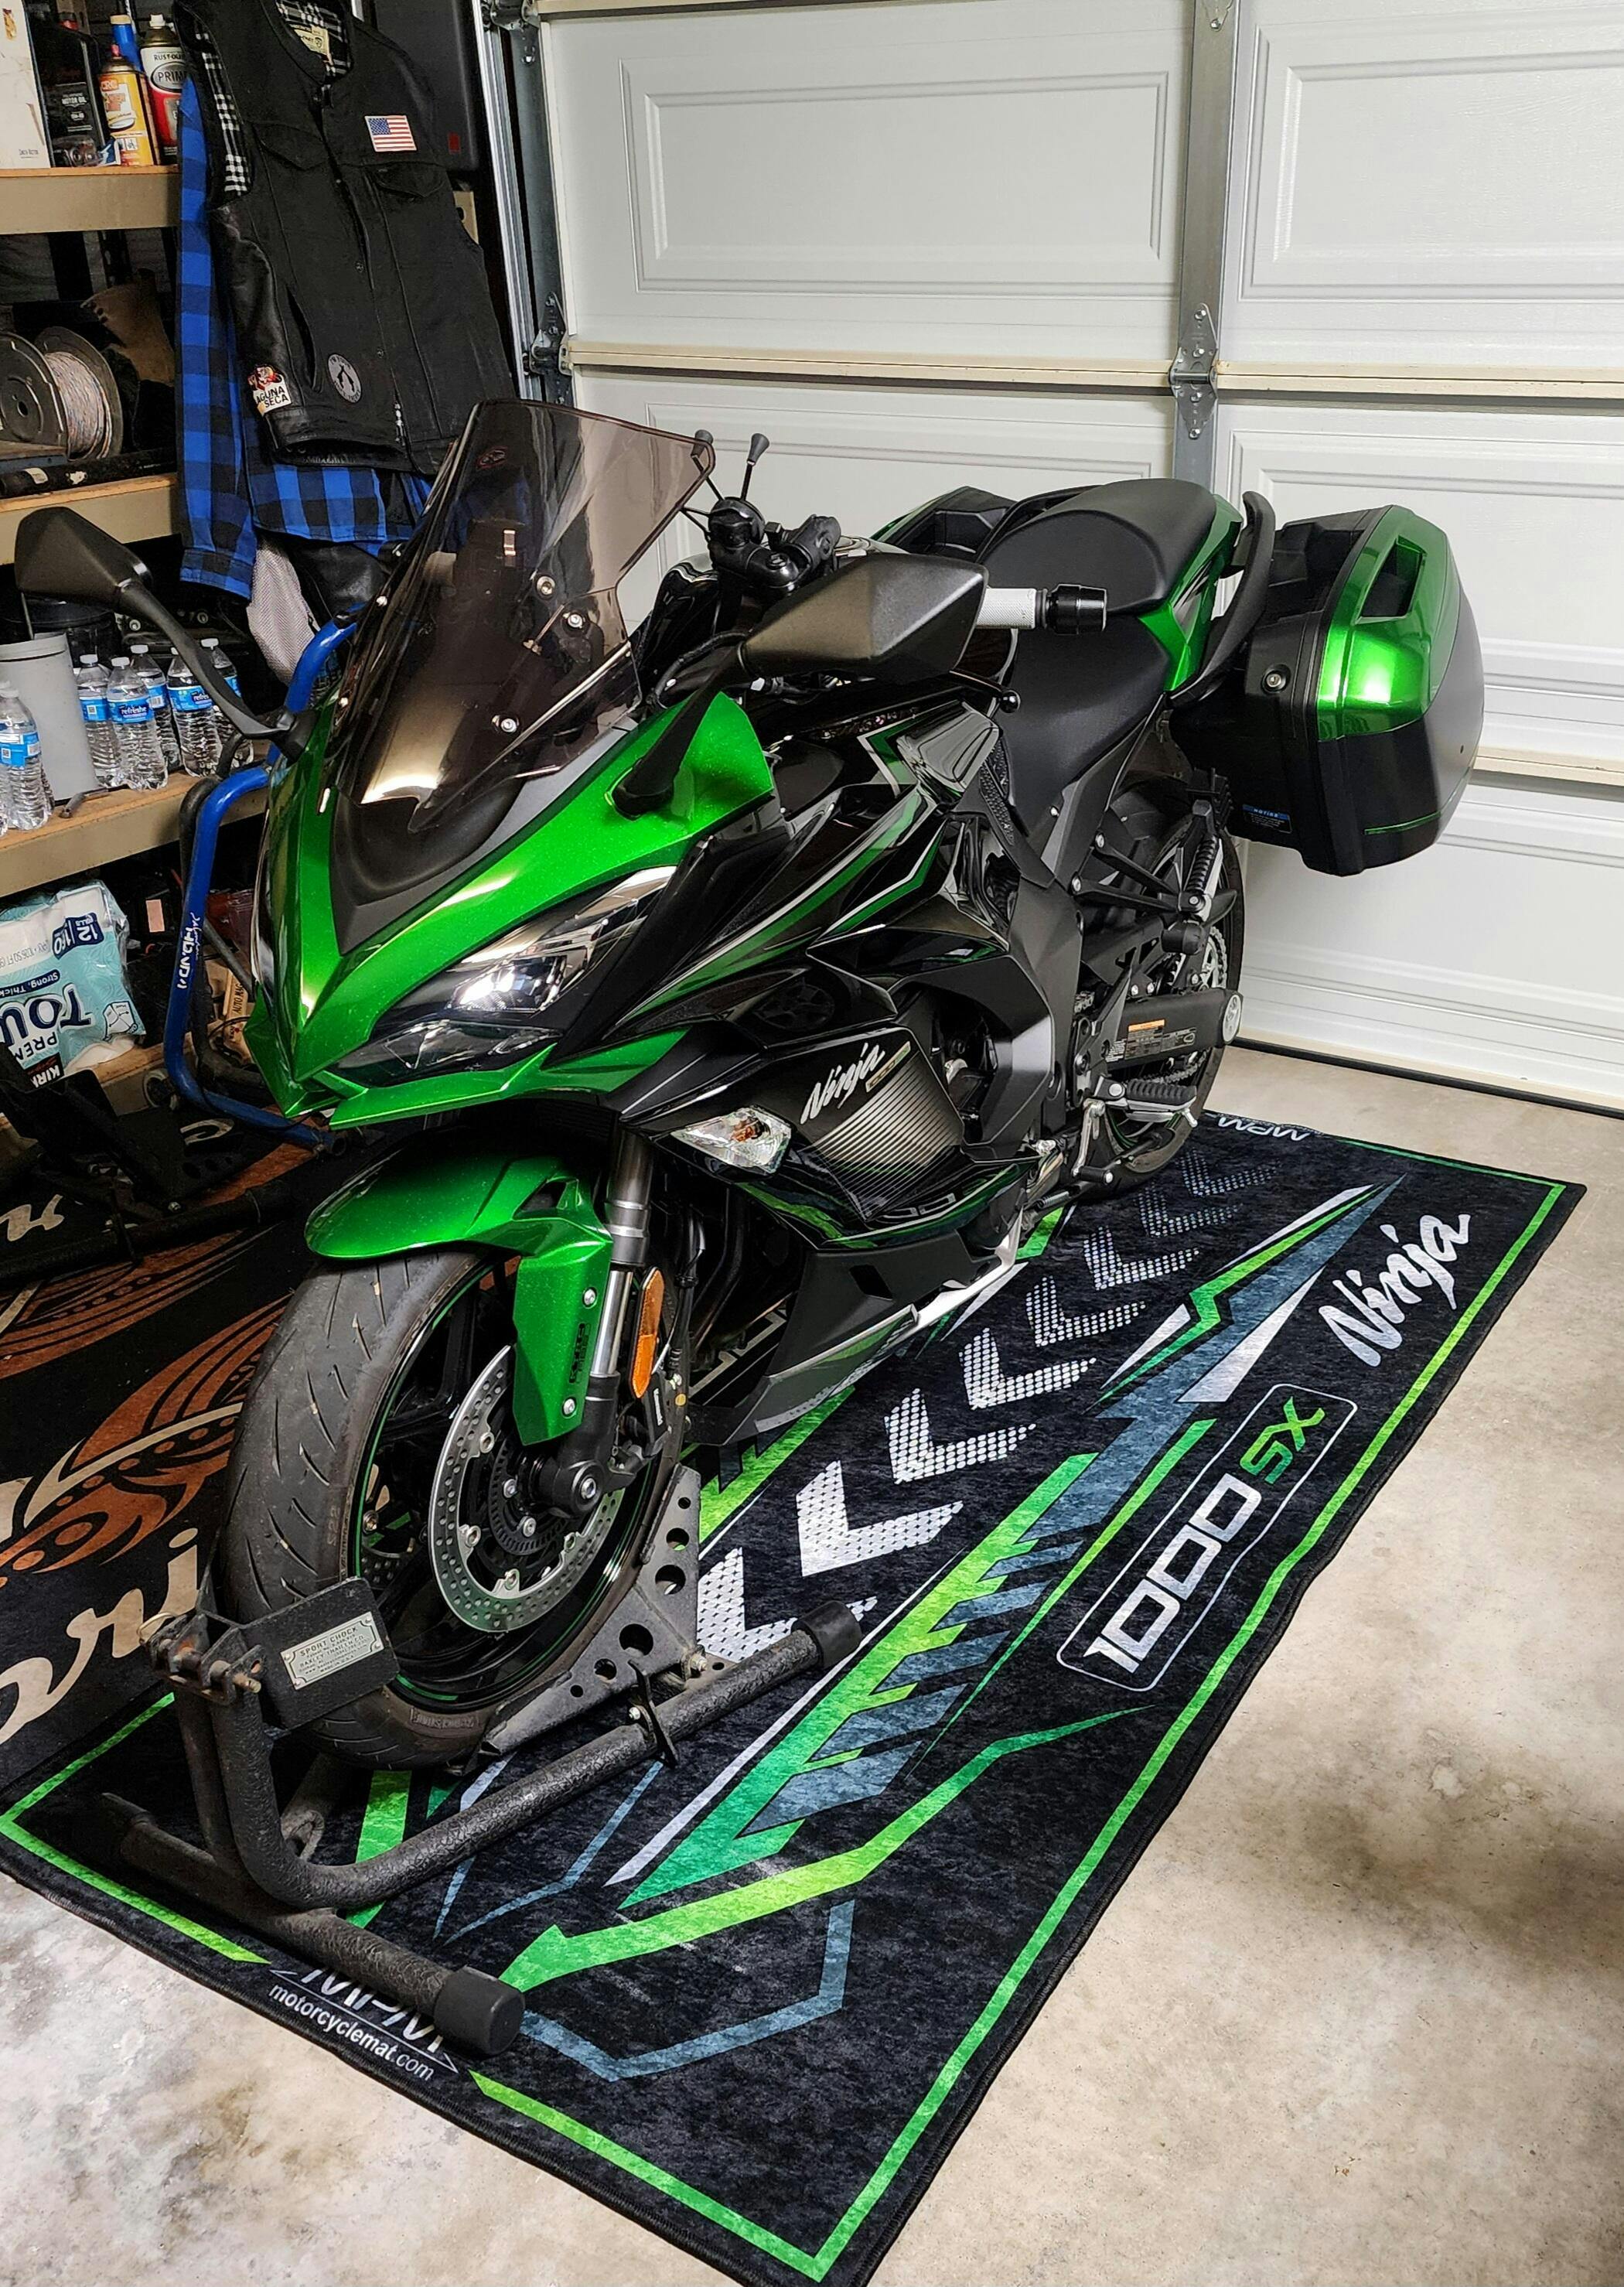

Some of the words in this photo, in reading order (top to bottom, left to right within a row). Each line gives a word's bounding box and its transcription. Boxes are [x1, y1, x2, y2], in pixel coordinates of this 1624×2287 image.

[256, 386, 285, 404] AGUNA
[264, 394, 289, 408] SECA
[77, 923, 98, 941] 12
[0, 986, 26, 997] Thick
[233, 995, 244, 1013] AUTO
[800, 1042, 885, 1125] Ninja
[1218, 1117, 1309, 1141] MPM
[1319, 1213, 1471, 1367] Ninja
[300, 1640, 327, 1657] SPORT
[329, 1627, 358, 1643] CHOCK
[268, 1982, 434, 2081] motorcyclemat.com
